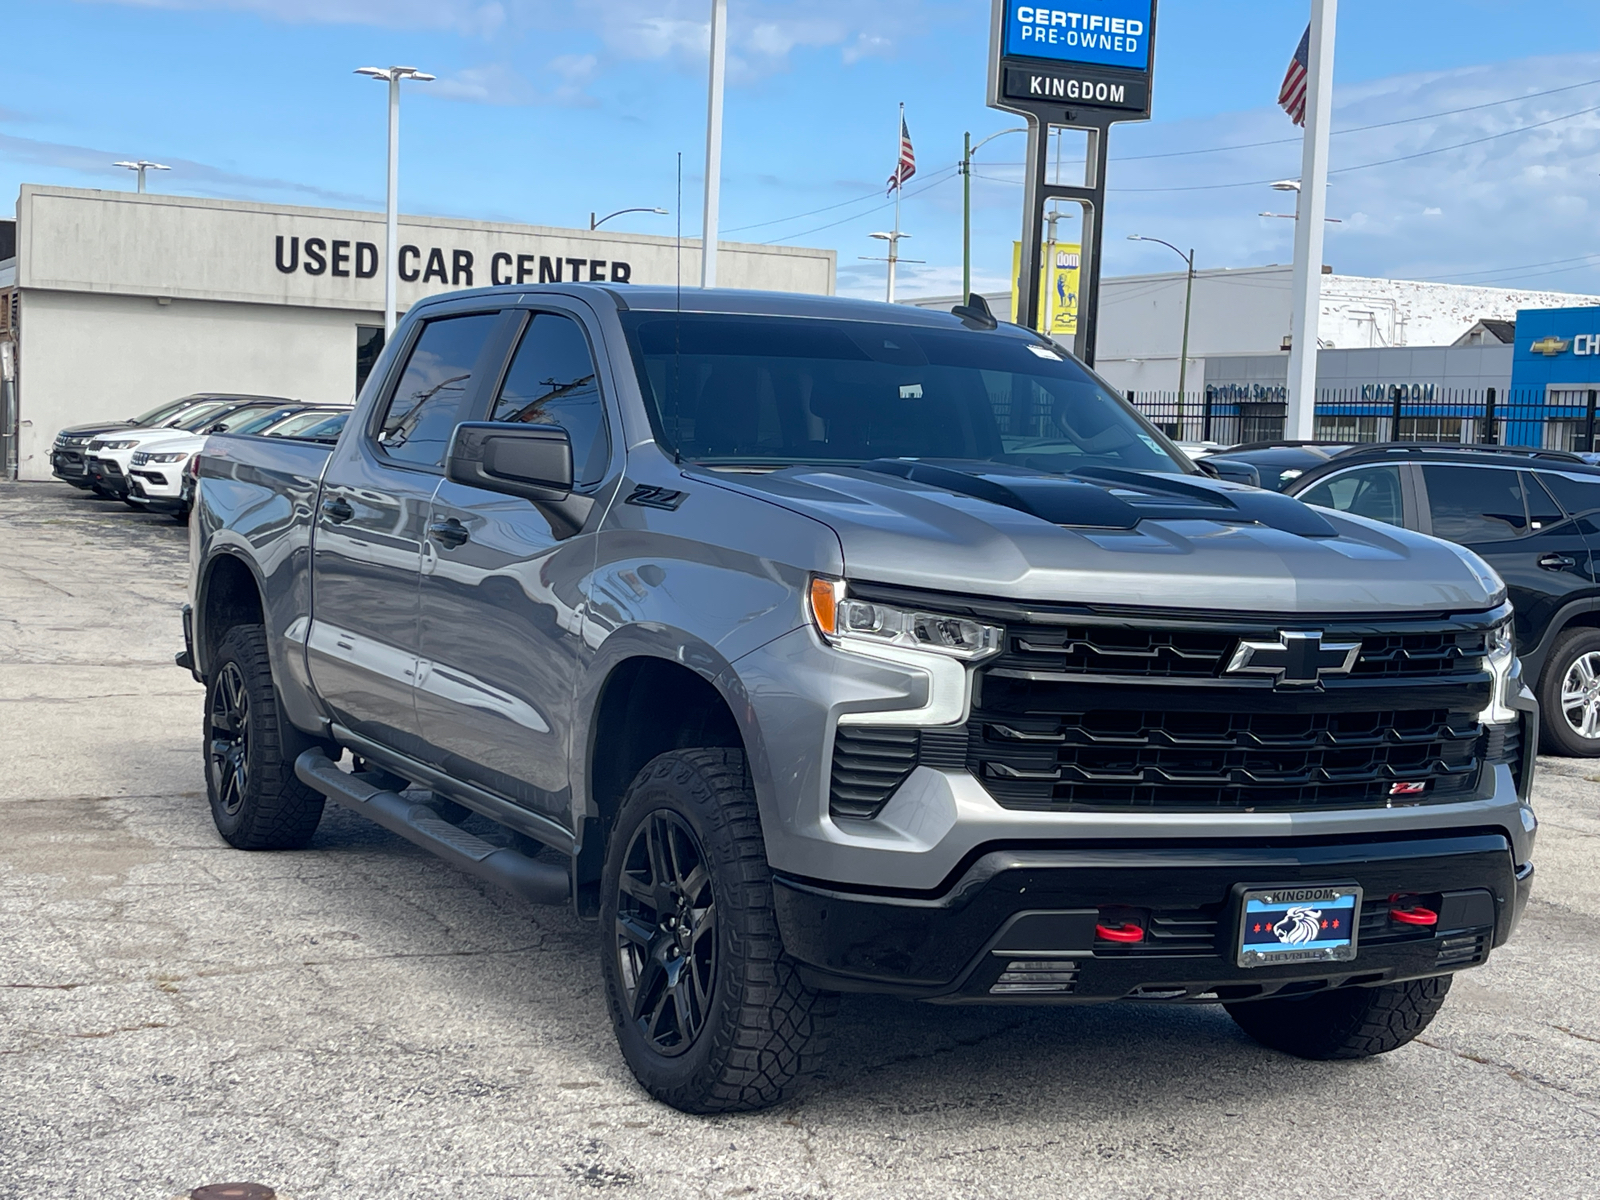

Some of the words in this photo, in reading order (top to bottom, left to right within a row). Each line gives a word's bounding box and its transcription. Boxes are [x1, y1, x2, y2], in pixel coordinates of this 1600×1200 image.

[1017, 6, 1143, 36] CERTIFIED
[1022, 25, 1137, 53] PRE-OWNED
[1030, 76, 1125, 103] KINGDOM
[275, 235, 379, 279] USED
[398, 244, 474, 286] CAR
[491, 252, 632, 286] CENTER
[1361, 383, 1436, 401] KINGDOM
[1272, 889, 1335, 901] KINGDOM
